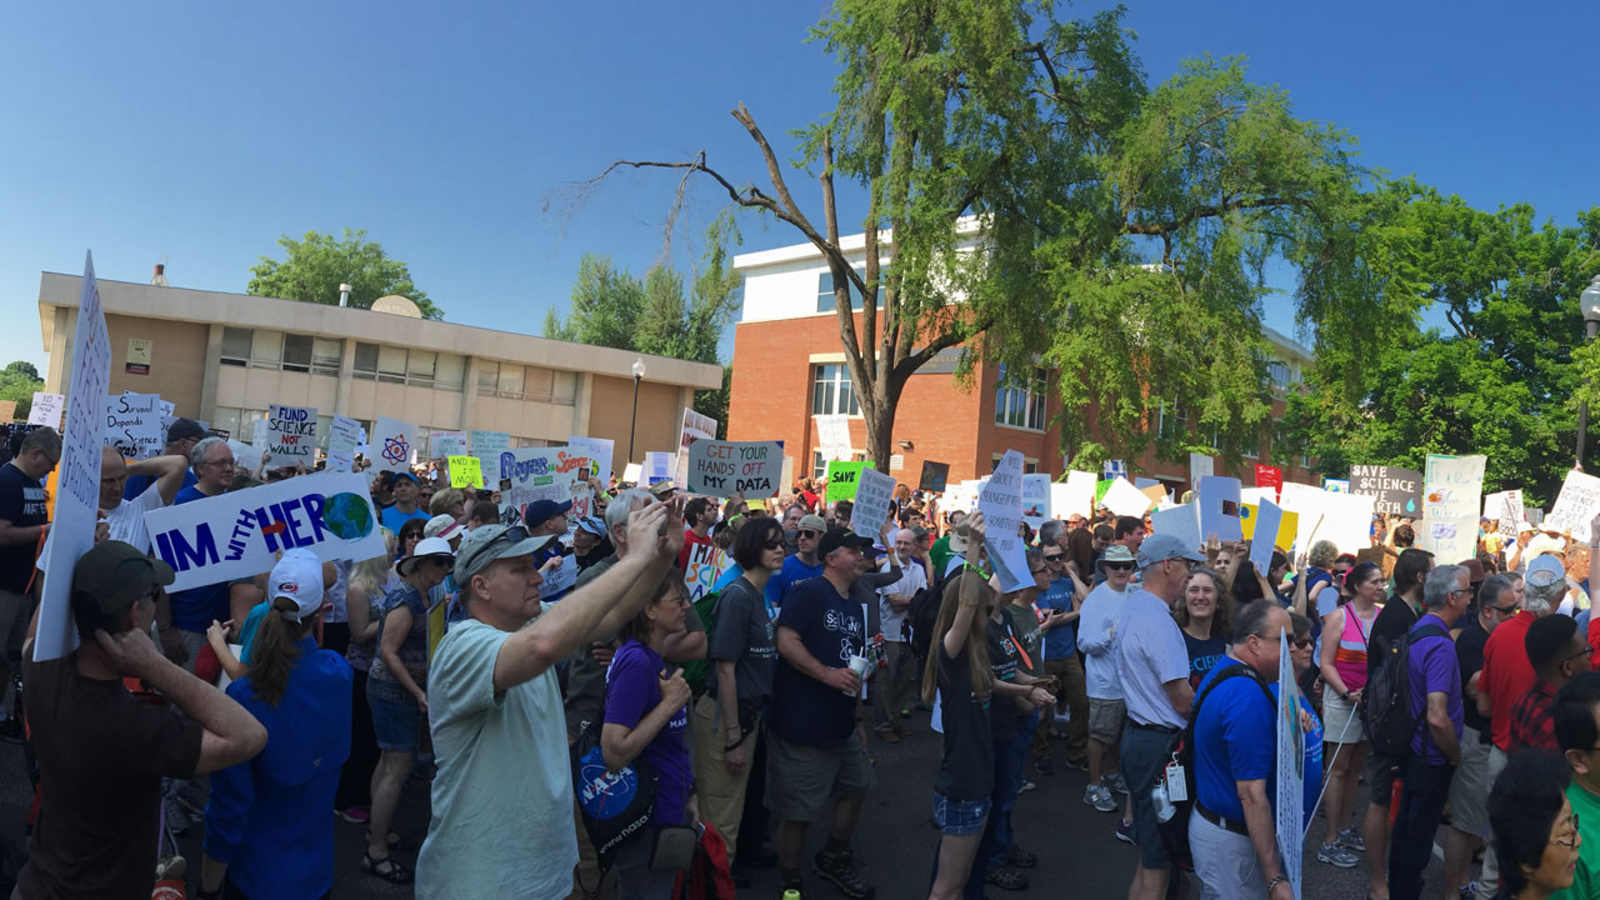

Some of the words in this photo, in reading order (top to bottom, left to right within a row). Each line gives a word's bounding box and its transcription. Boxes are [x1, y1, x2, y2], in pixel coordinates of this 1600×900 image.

[107, 415, 144, 429] Depends
[278, 407, 308, 422] FUND
[269, 418, 316, 436] SCIENCE
[281, 434, 301, 445] NOT
[269, 443, 310, 456] WALLS
[707, 445, 735, 460] GET
[739, 446, 768, 460] YOUR
[451, 458, 468, 466] AND
[500, 451, 549, 483] Progress
[697, 459, 737, 476] HANDS
[742, 462, 766, 476] OFF
[832, 471, 856, 483] SAVE
[1352, 465, 1388, 478] SAVE
[704, 475, 727, 490] MY
[736, 477, 771, 492] DATA
[1360, 478, 1416, 493] SCIENCE
[1561, 490, 1596, 508] SCIENCE
[1373, 501, 1402, 514] RTH
[224, 509, 257, 561] WITH
[254, 493, 331, 553] HER
[694, 544, 727, 569] MAKE
[1189, 654, 1225, 672] CIEN
[670, 718, 687, 728] MAR
[583, 767, 634, 805] NASA
